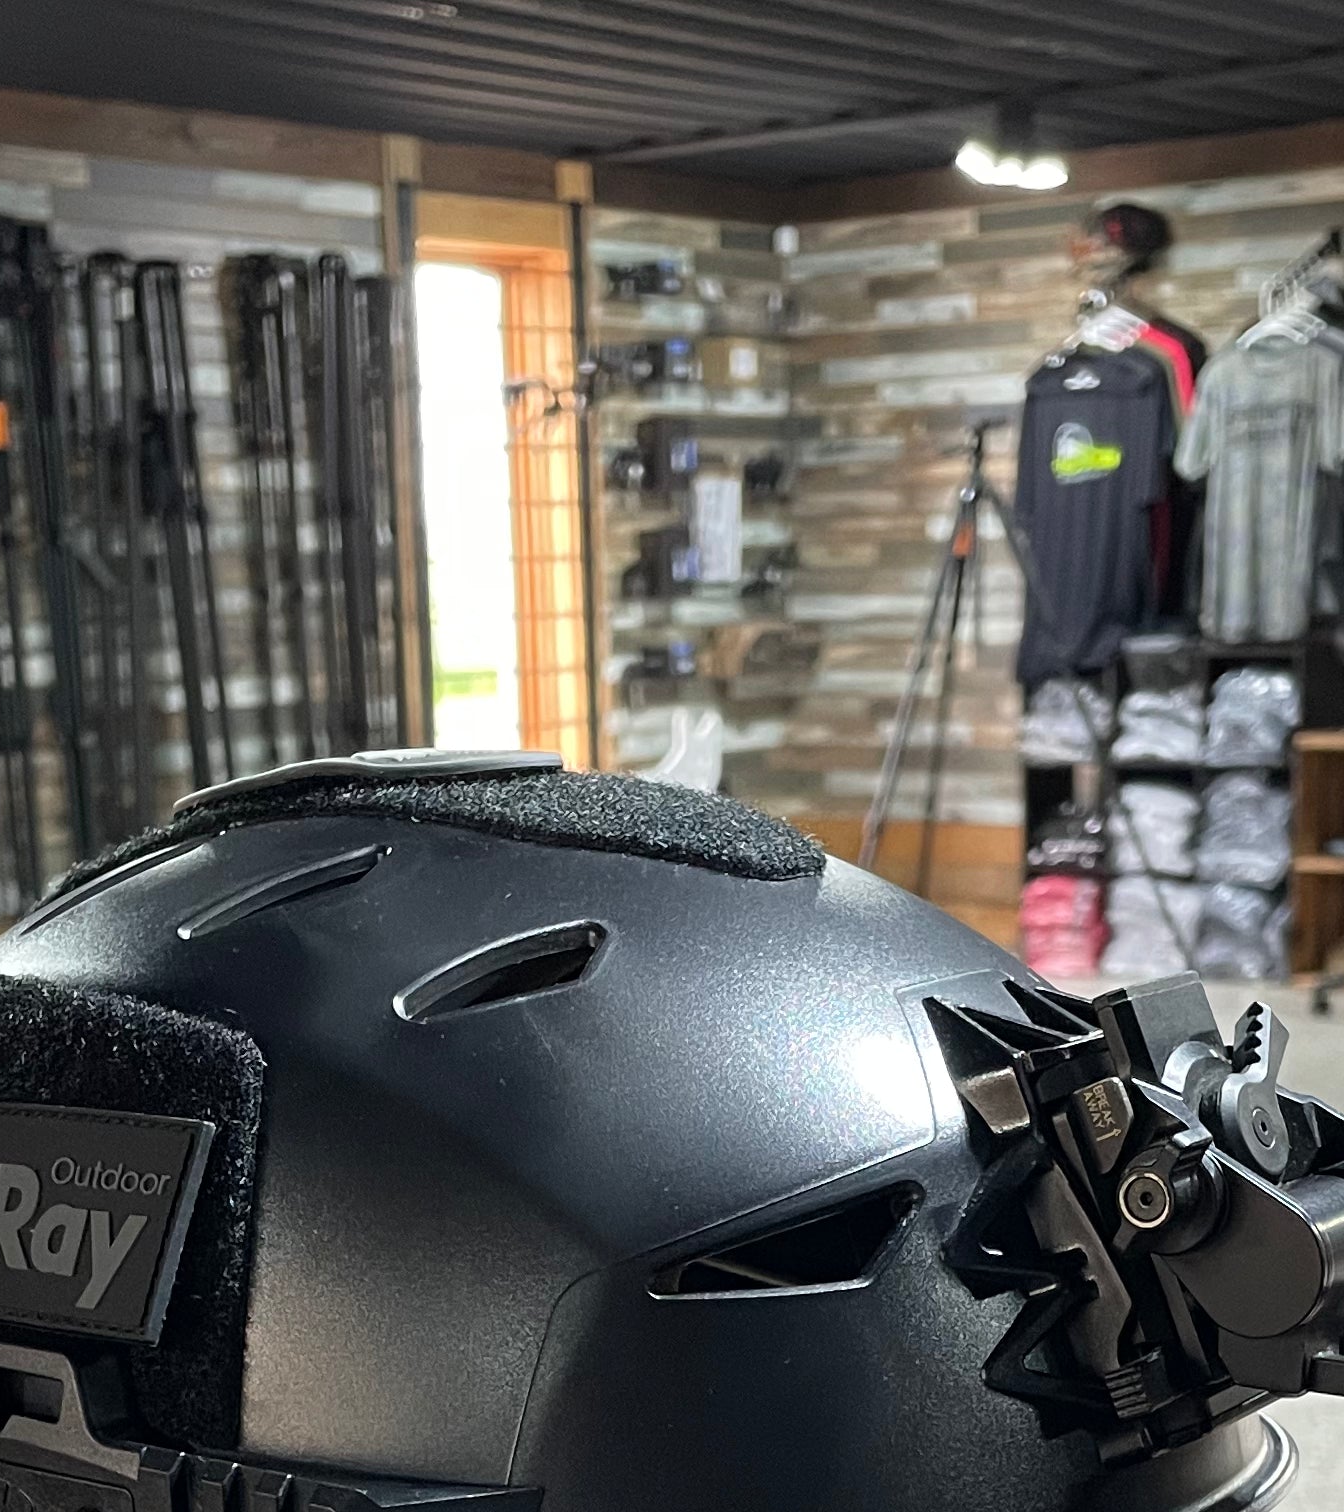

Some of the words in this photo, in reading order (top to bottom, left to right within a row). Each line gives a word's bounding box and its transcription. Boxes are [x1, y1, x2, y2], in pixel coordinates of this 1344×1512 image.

[1083, 1092, 1106, 1128] AWAY
[1093, 1084, 1116, 1127] BREAK
[51, 1156, 171, 1196] Outdoor
